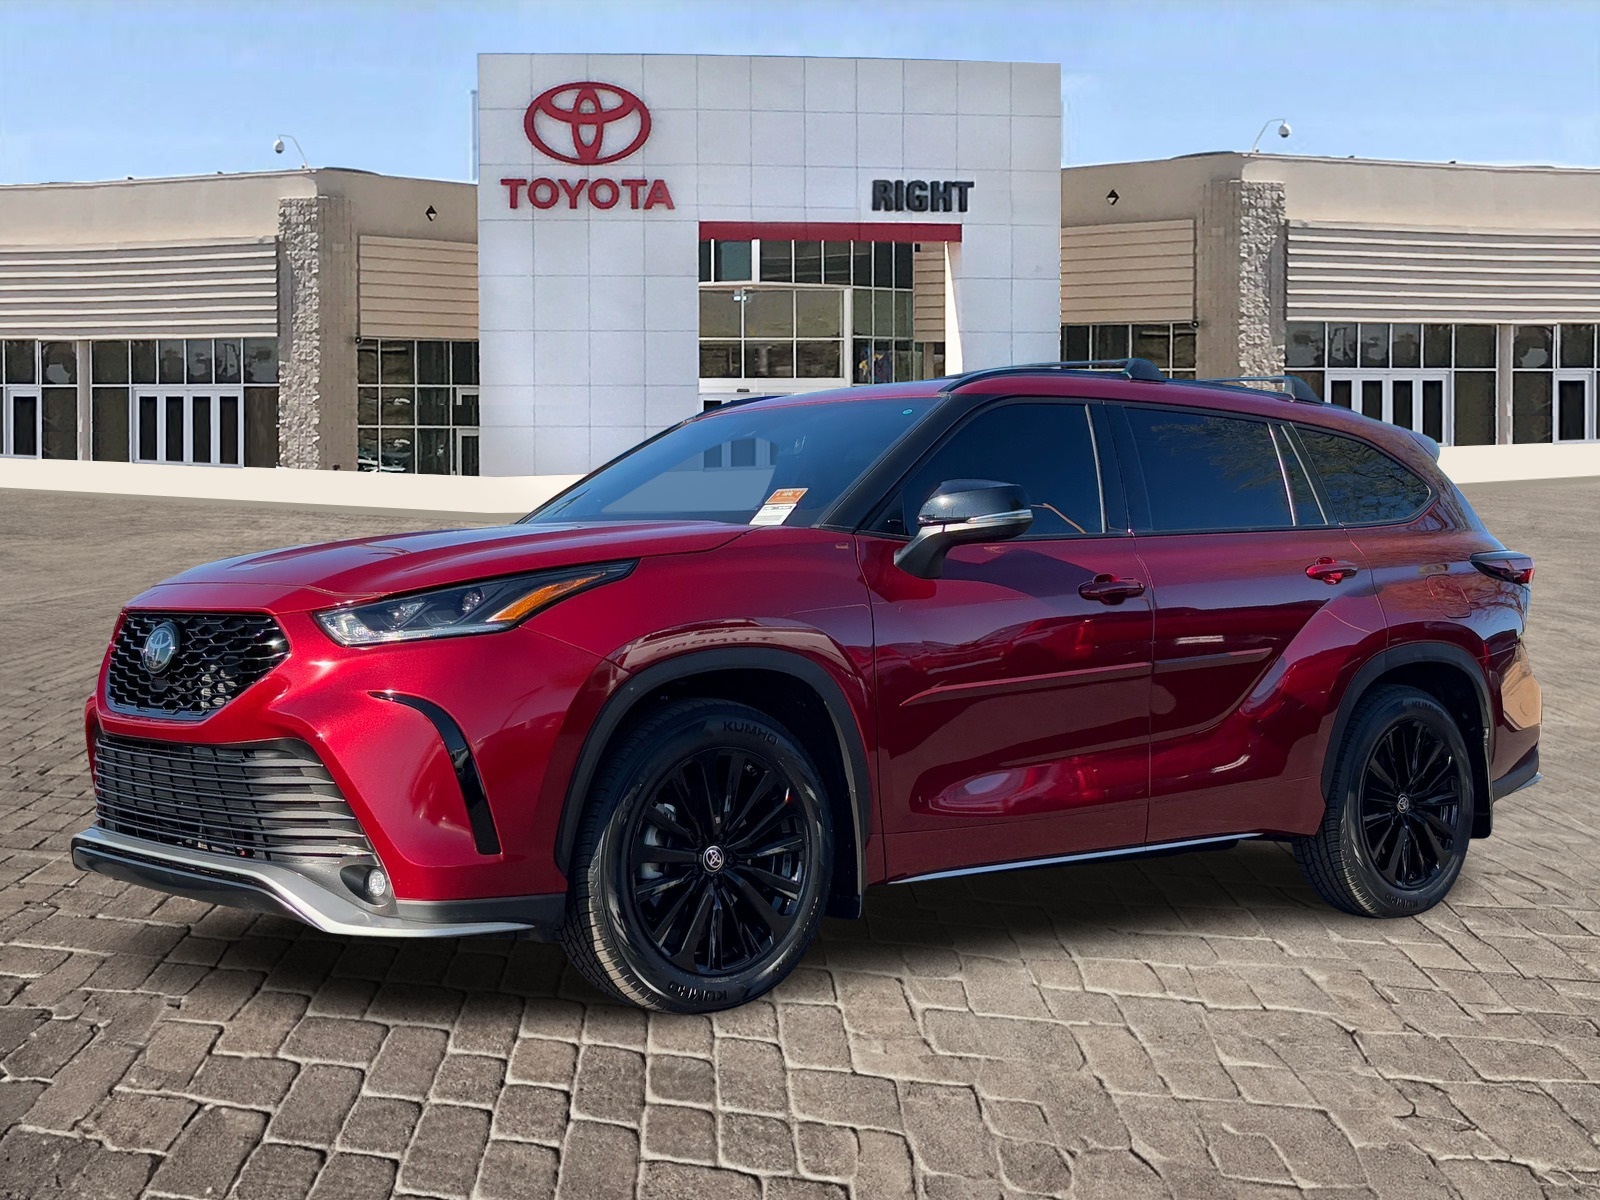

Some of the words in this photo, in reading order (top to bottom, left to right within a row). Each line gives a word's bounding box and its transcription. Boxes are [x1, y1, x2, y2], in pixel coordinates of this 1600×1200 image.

[500, 178, 675, 210] TOYOTA
[872, 180, 975, 212] RIGHT
[723, 720, 780, 745] KUMHO
